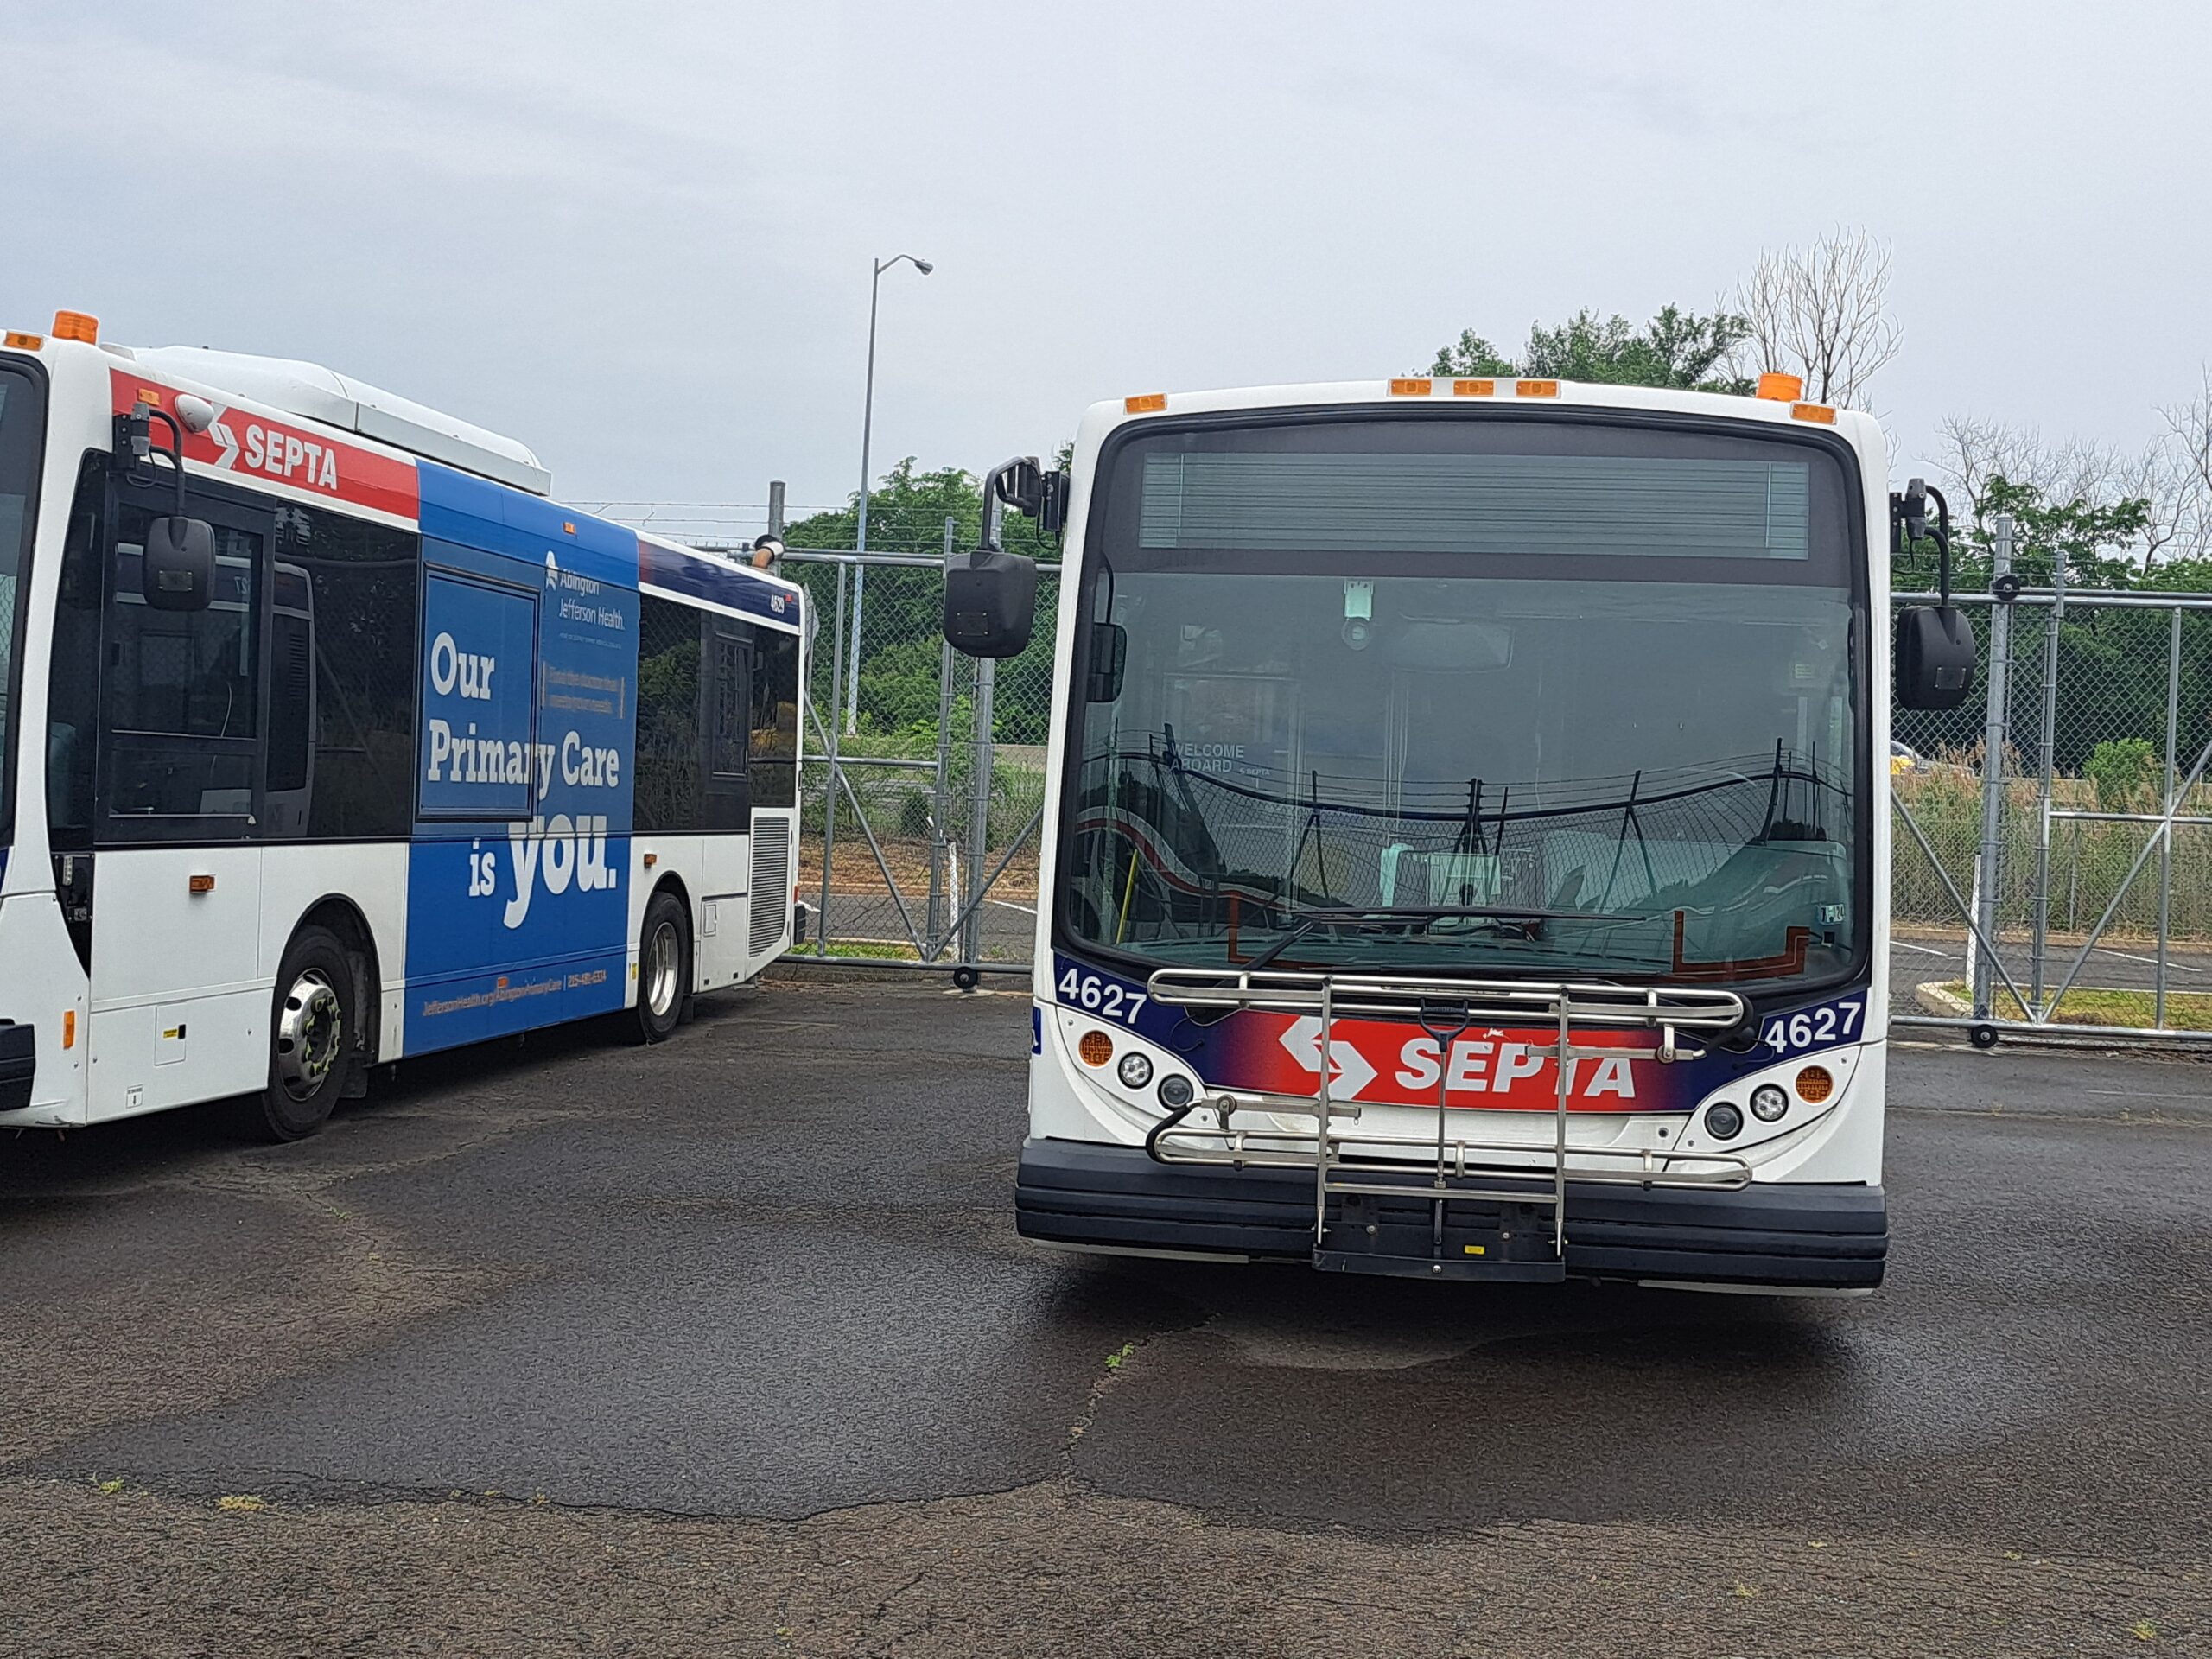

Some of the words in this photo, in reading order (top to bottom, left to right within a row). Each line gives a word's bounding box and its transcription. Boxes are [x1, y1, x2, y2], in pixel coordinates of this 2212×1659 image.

[245, 424, 338, 491] SEPTA
[560, 569, 600, 597] Abington
[559, 598, 596, 624] Jefferson
[431, 632, 495, 701] Our
[427, 719, 555, 800] Primary
[561, 730, 620, 787] Care
[1170, 758, 1233, 772] ABOARD
[1172, 743, 1245, 758] WELCOME
[469, 836, 496, 897] is
[503, 814, 617, 930] you.
[1058, 969, 1147, 1025] 4627
[1764, 1001, 1862, 1053] 4627
